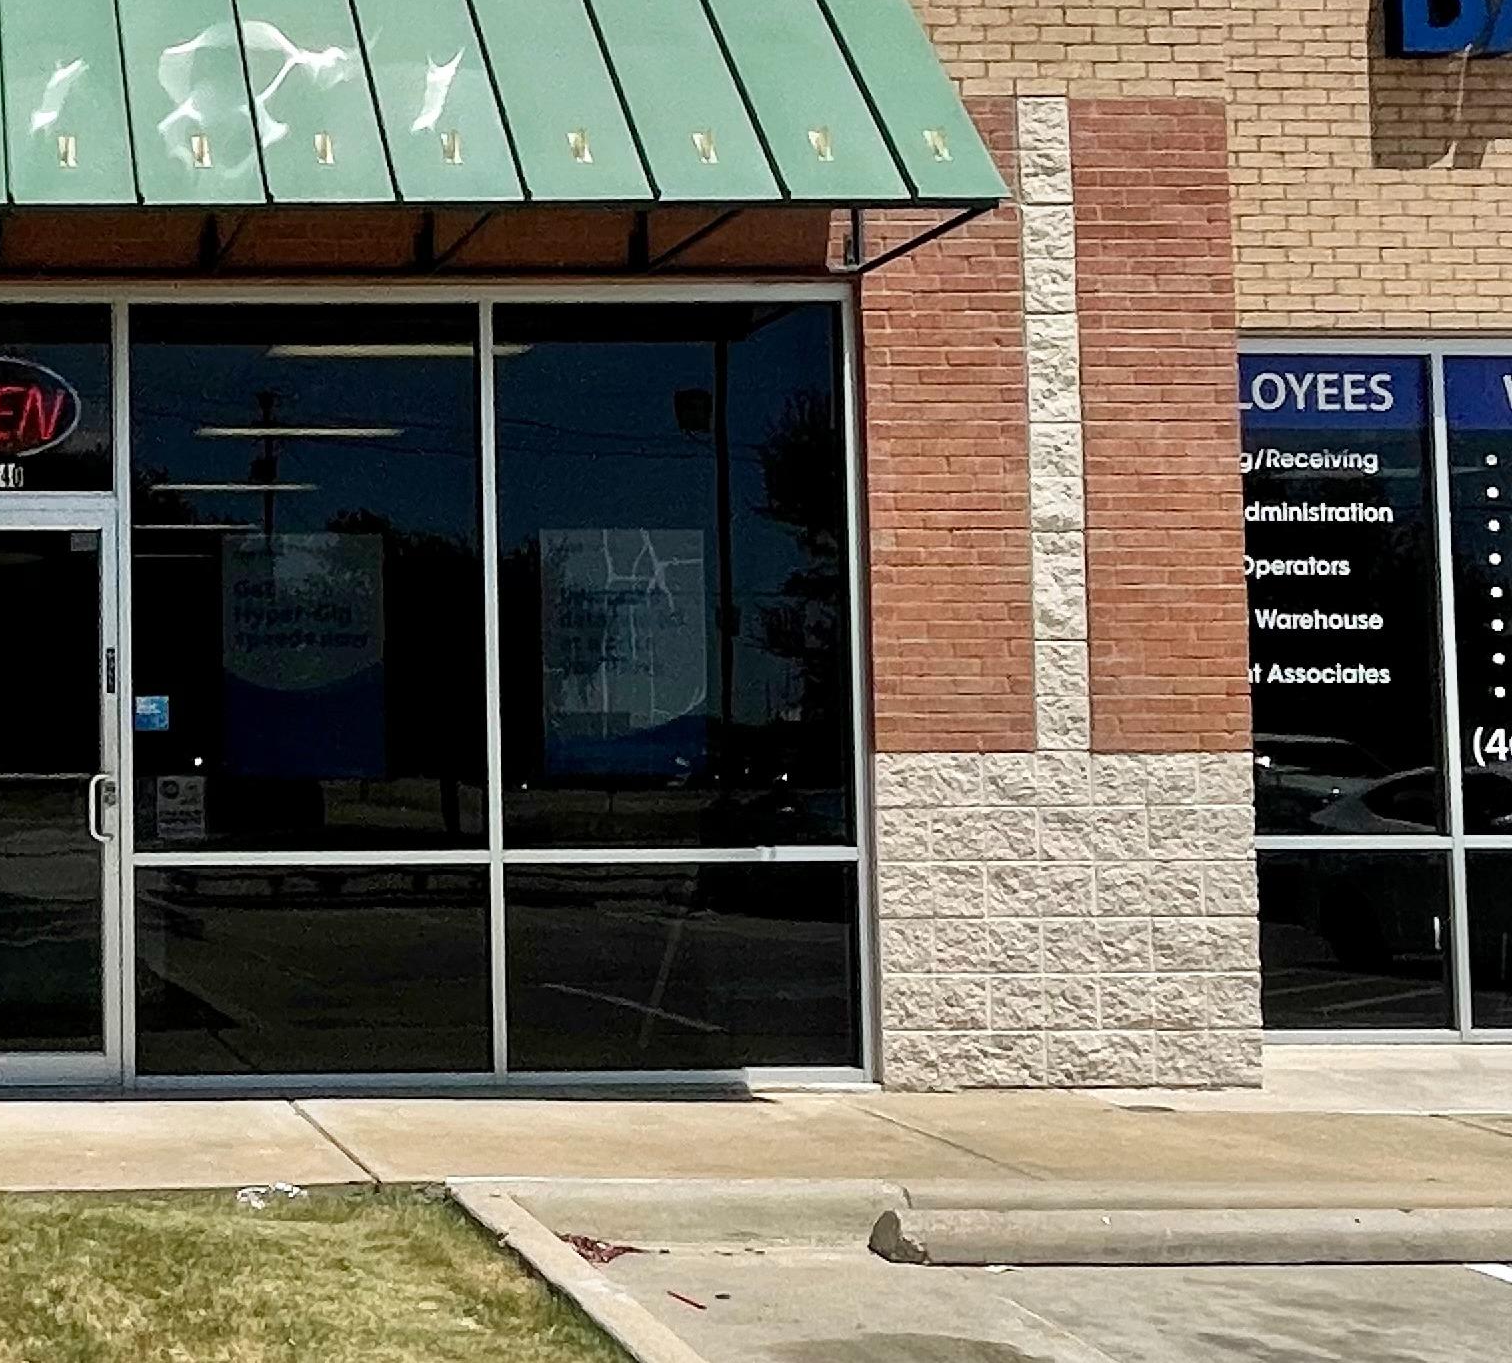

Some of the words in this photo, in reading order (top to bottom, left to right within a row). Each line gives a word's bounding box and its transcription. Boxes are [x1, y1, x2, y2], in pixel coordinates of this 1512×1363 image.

[1244, 501, 1394, 523] dministration
[1254, 608, 1384, 630] Warehouse
[1267, 662, 1392, 684] Associates
[1473, 726, 1512, 767] (4
